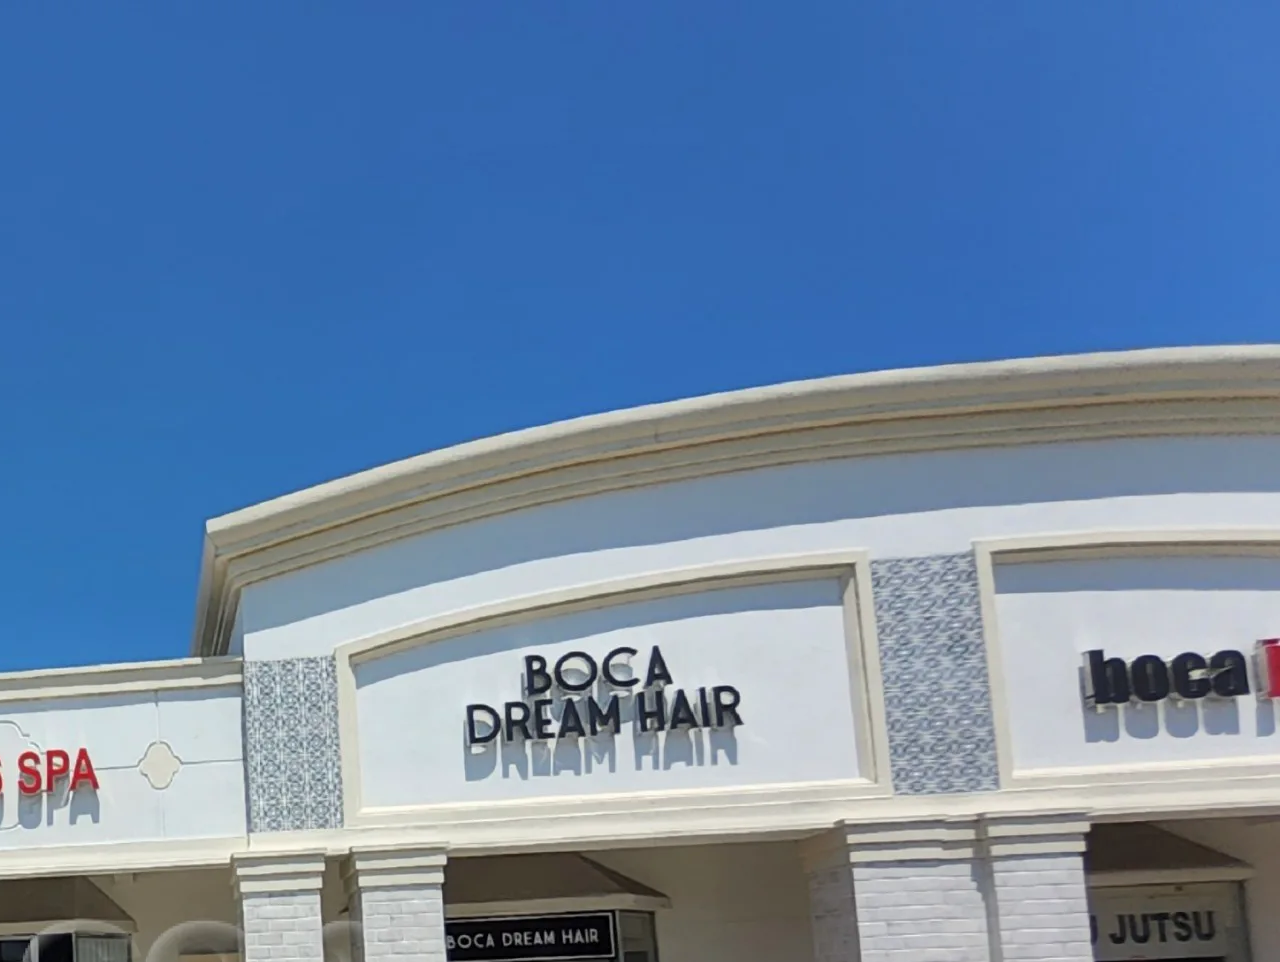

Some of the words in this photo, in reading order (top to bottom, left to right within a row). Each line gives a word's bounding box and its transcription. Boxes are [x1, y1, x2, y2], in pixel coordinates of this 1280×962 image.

[524, 645, 674, 697] BOCA
[1083, 649, 1251, 704] boca
[466, 694, 621, 745] DREAM
[636, 685, 745, 733] HAIR
[17, 747, 100, 796] SPA
[446, 933, 495, 949] BOCA
[501, 929, 556, 948] DREAM
[561, 928, 600, 945] HAIR
[1108, 910, 1217, 945] JUTSU
